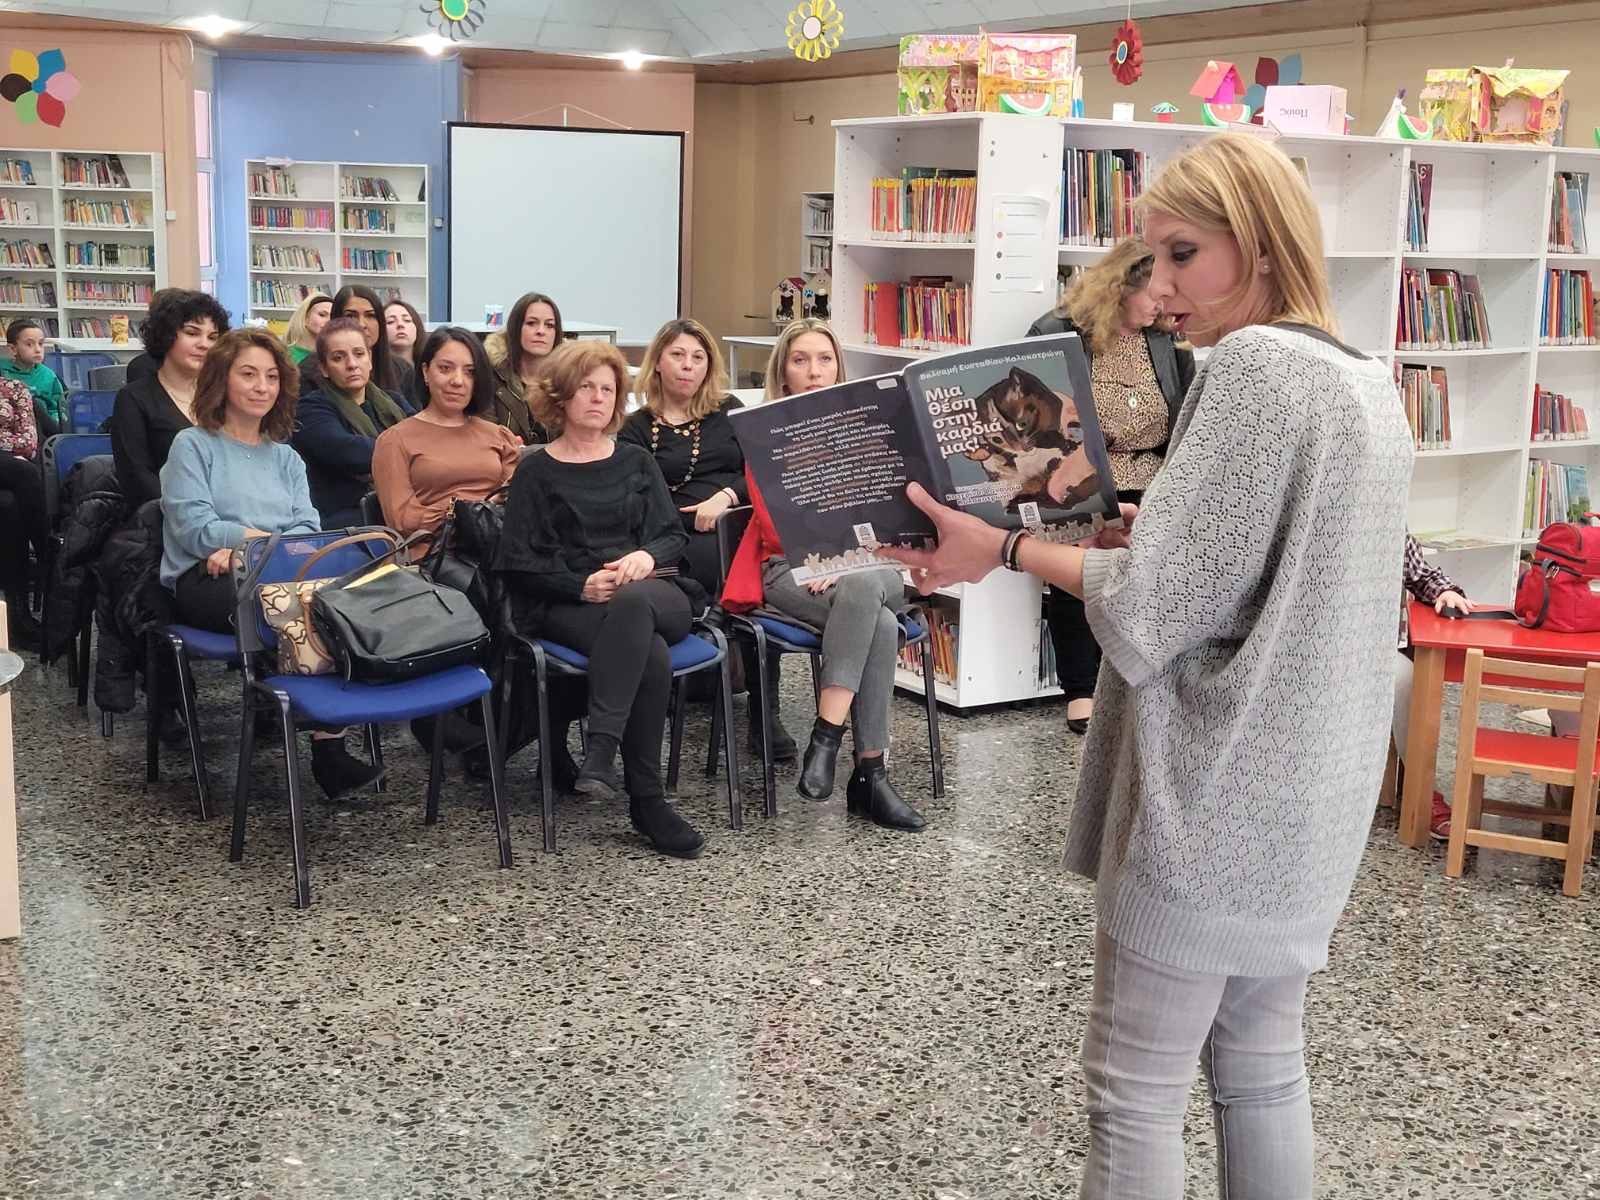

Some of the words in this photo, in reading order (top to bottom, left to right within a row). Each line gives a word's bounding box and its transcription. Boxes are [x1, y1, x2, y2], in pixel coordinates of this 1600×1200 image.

[926, 385, 964, 404] Μια
[928, 398, 977, 416] θέση
[933, 411, 978, 430] στην
[936, 417, 1003, 443] καρδιά
[941, 437, 980, 460] μας!
